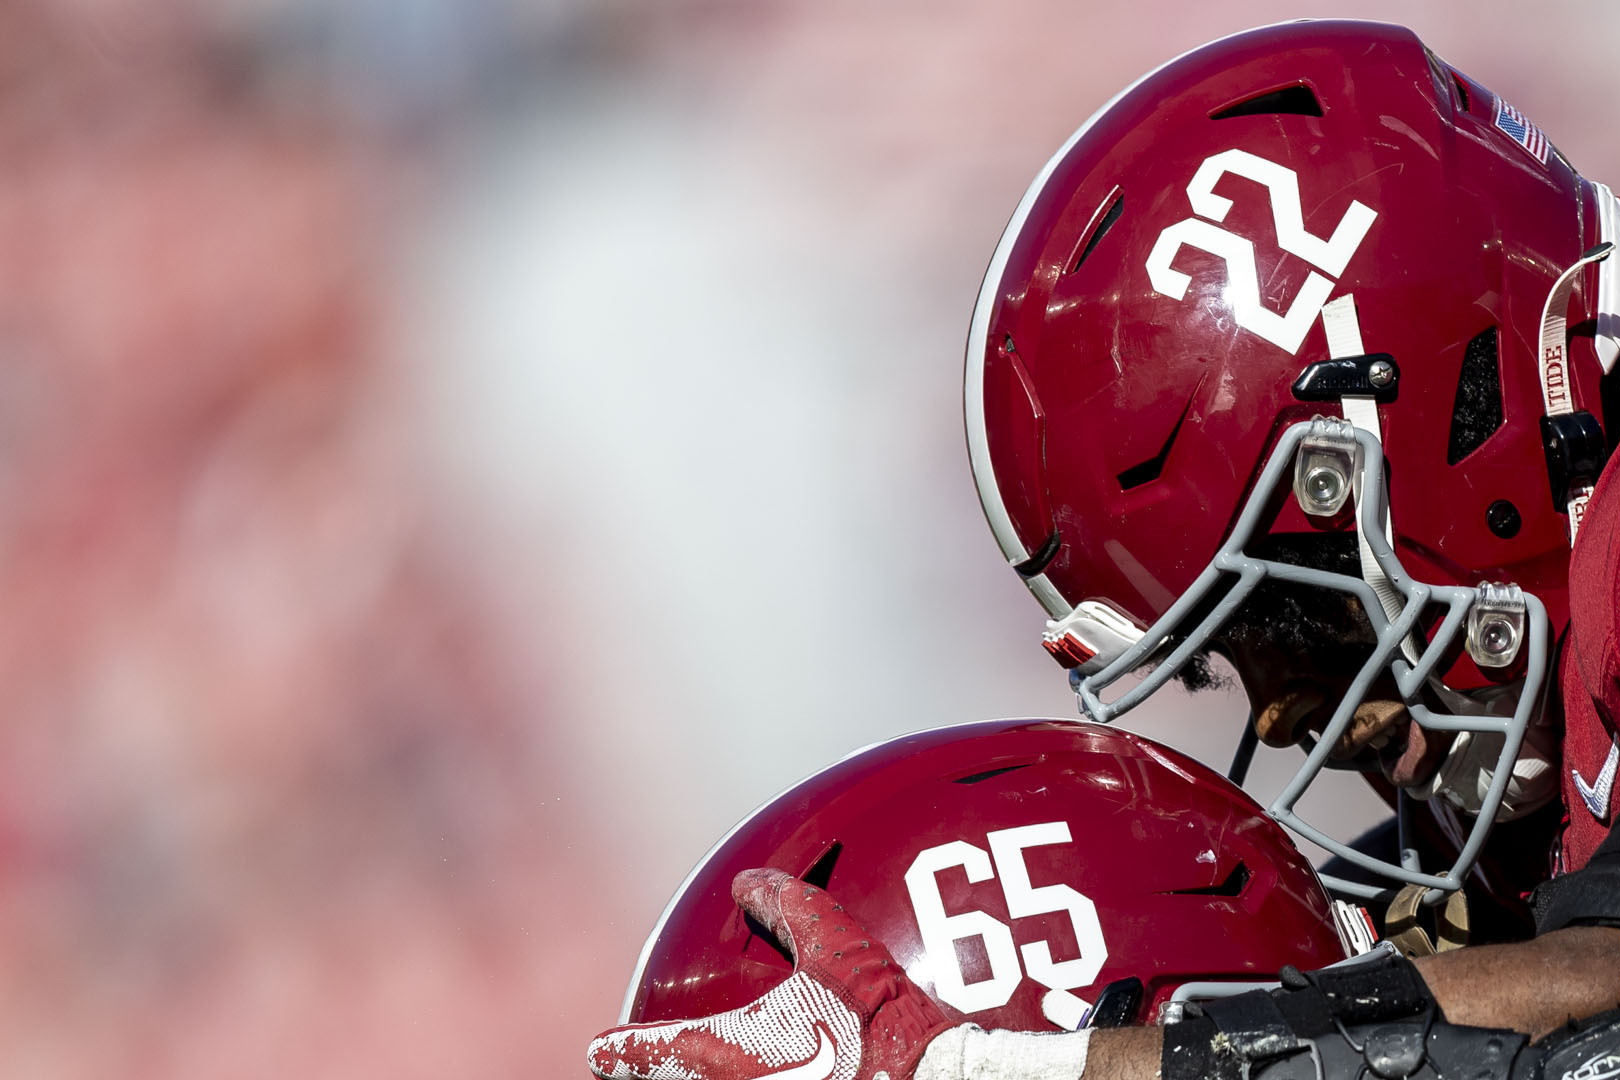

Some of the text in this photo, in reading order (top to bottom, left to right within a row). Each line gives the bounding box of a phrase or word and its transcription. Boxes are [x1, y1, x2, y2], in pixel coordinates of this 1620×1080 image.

[1146, 148, 1378, 355] 22
[1545, 345, 1566, 407] TIDE
[904, 821, 1108, 1014] 65
